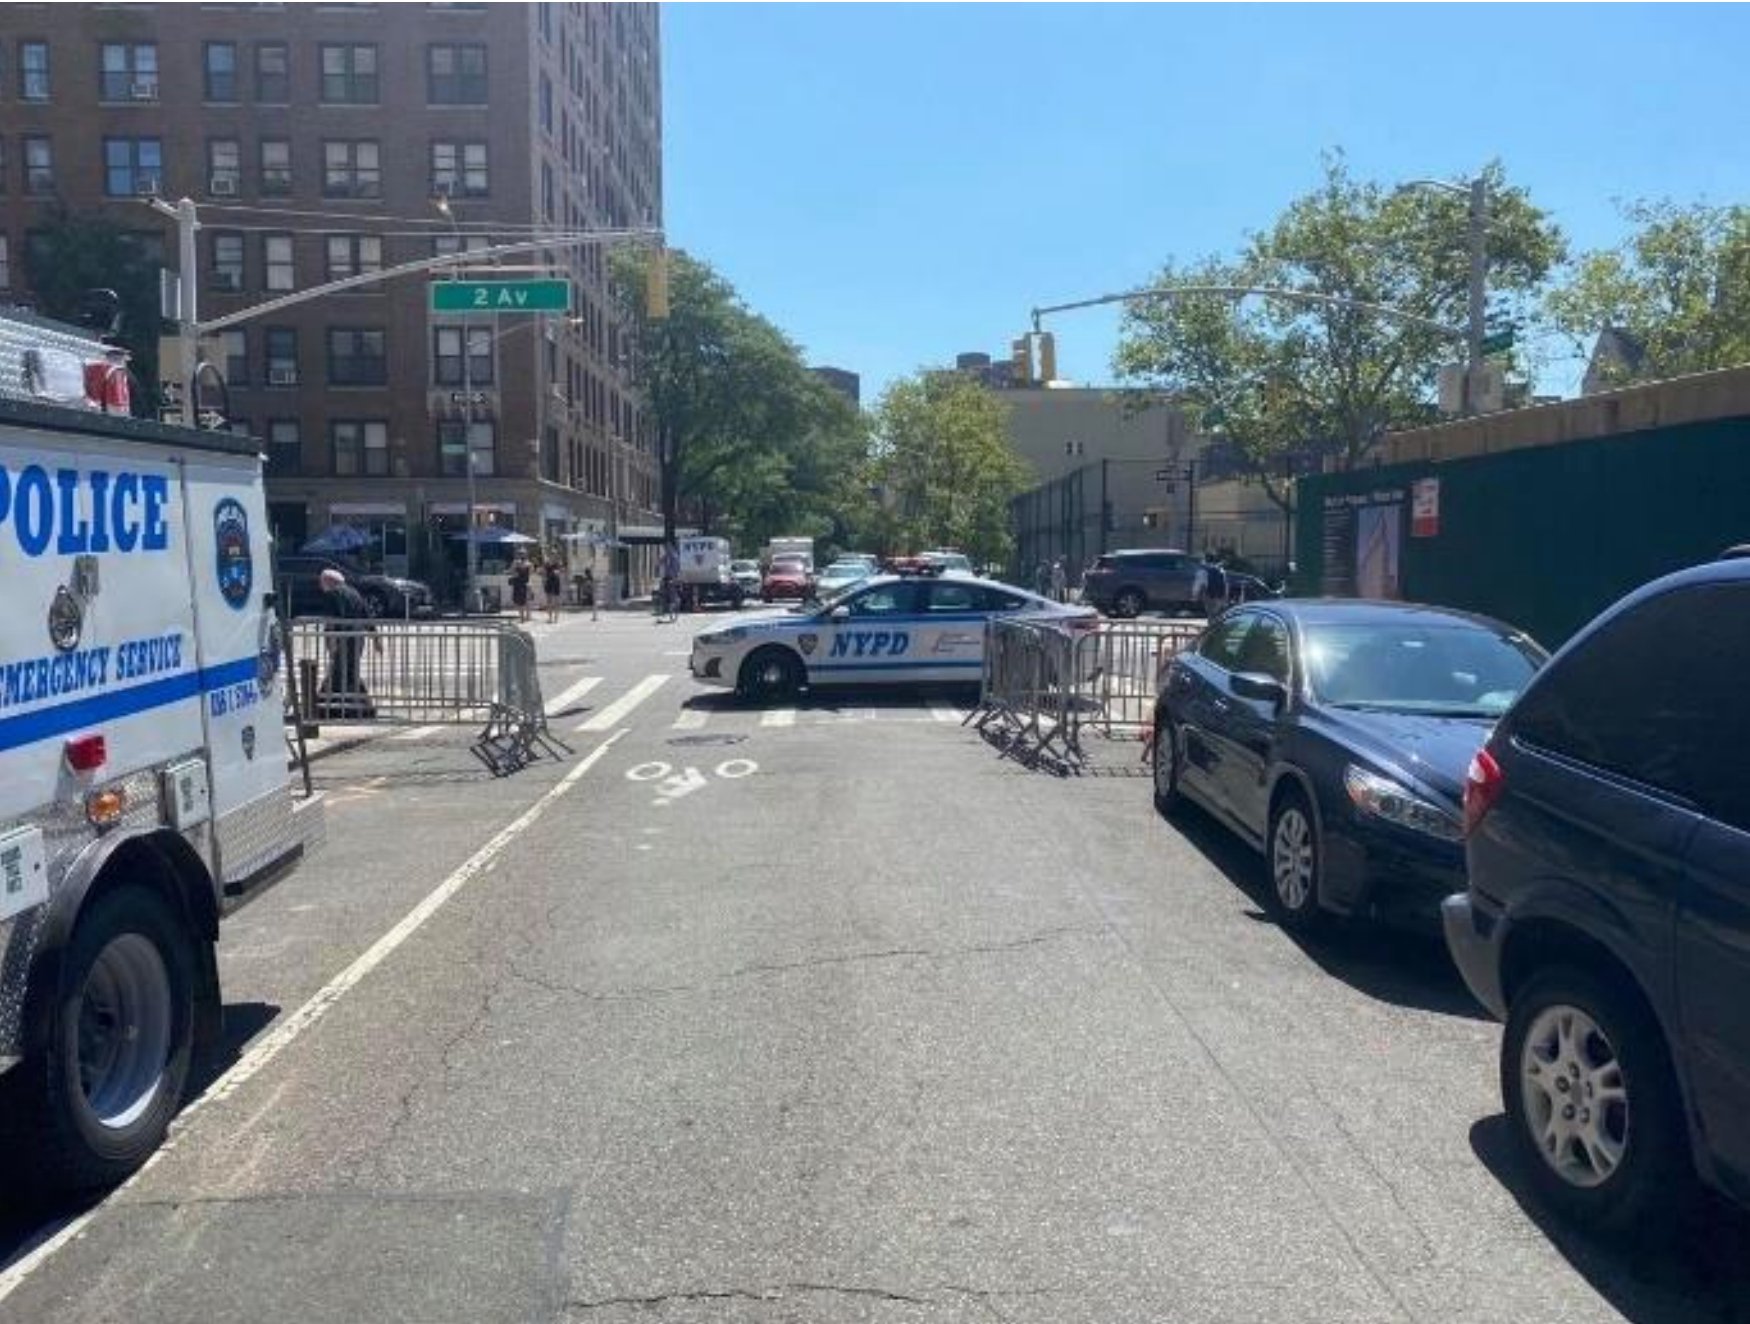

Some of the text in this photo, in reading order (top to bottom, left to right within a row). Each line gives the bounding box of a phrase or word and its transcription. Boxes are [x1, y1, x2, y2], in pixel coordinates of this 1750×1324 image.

[474, 288, 528, 305] 2 Av
[830, 630, 909, 658] NYPD
[0, 634, 182, 708] MERGENCY SERVICE
